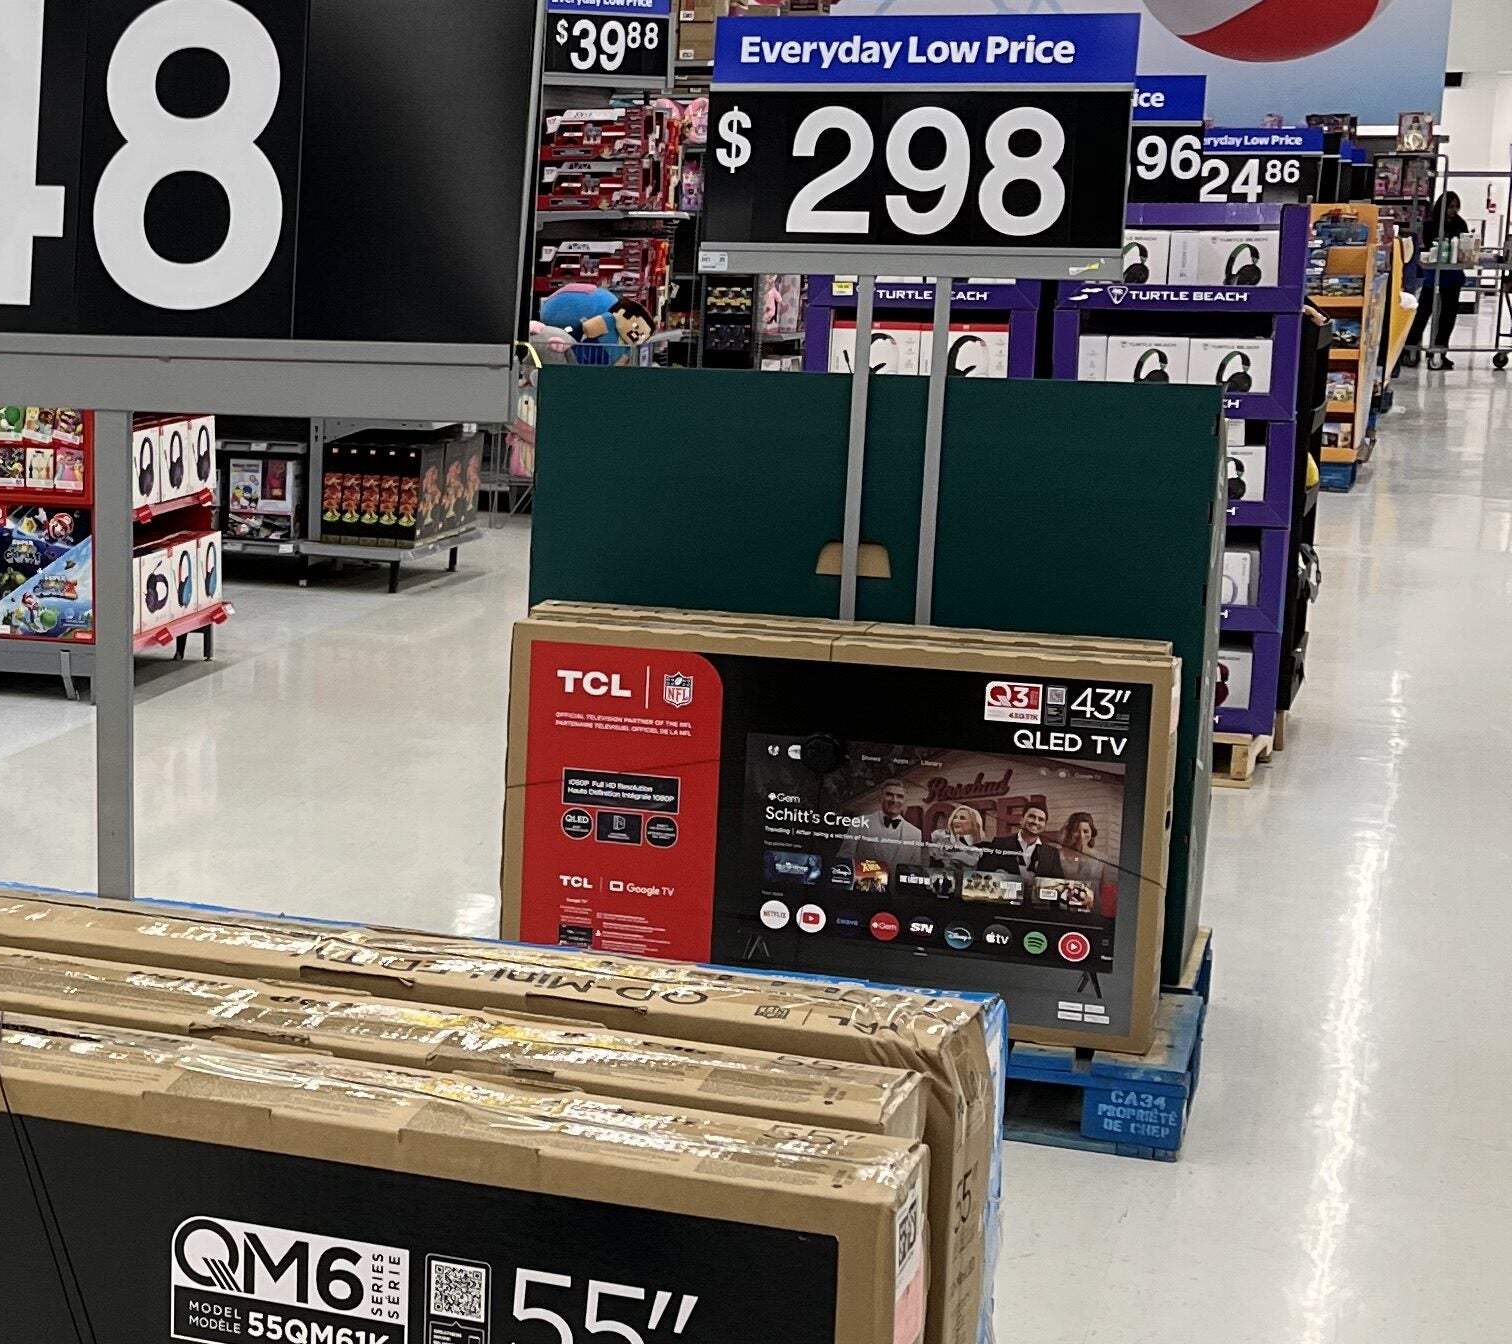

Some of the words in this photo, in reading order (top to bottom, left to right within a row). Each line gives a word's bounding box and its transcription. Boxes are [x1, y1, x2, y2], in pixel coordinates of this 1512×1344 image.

[740, 34, 902, 70] Everyday
[907, 35, 985, 64] Low
[988, 34, 1075, 65] Price
[1243, 135, 1270, 147] Low
[1271, 134, 1303, 147] Price
[877, 289, 933, 301] TURTLE
[1129, 291, 1190, 302] TURTLE
[1192, 291, 1249, 303] BEACH
[556, 669, 632, 698] TCL
[988, 681, 1030, 708] Q3
[1013, 729, 1083, 753] QLED
[1090, 735, 1128, 756] TV
[765, 806, 821, 825] Schitt's
[824, 812, 871, 829] Creek
[559, 874, 593, 889] TCL
[626, 882, 660, 897] Google
[662, 886, 675, 897] TV
[1110, 1089, 1167, 1110] CA34
[1103, 1117, 1123, 1133] DE
[1129, 1121, 1170, 1139] CHEP
[173, 1217, 364, 1312] QM6
[370, 1252, 385, 1318] SERIES
[188, 1298, 242, 1320] MODEL
[188, 1312, 242, 1335] MODÈLE
